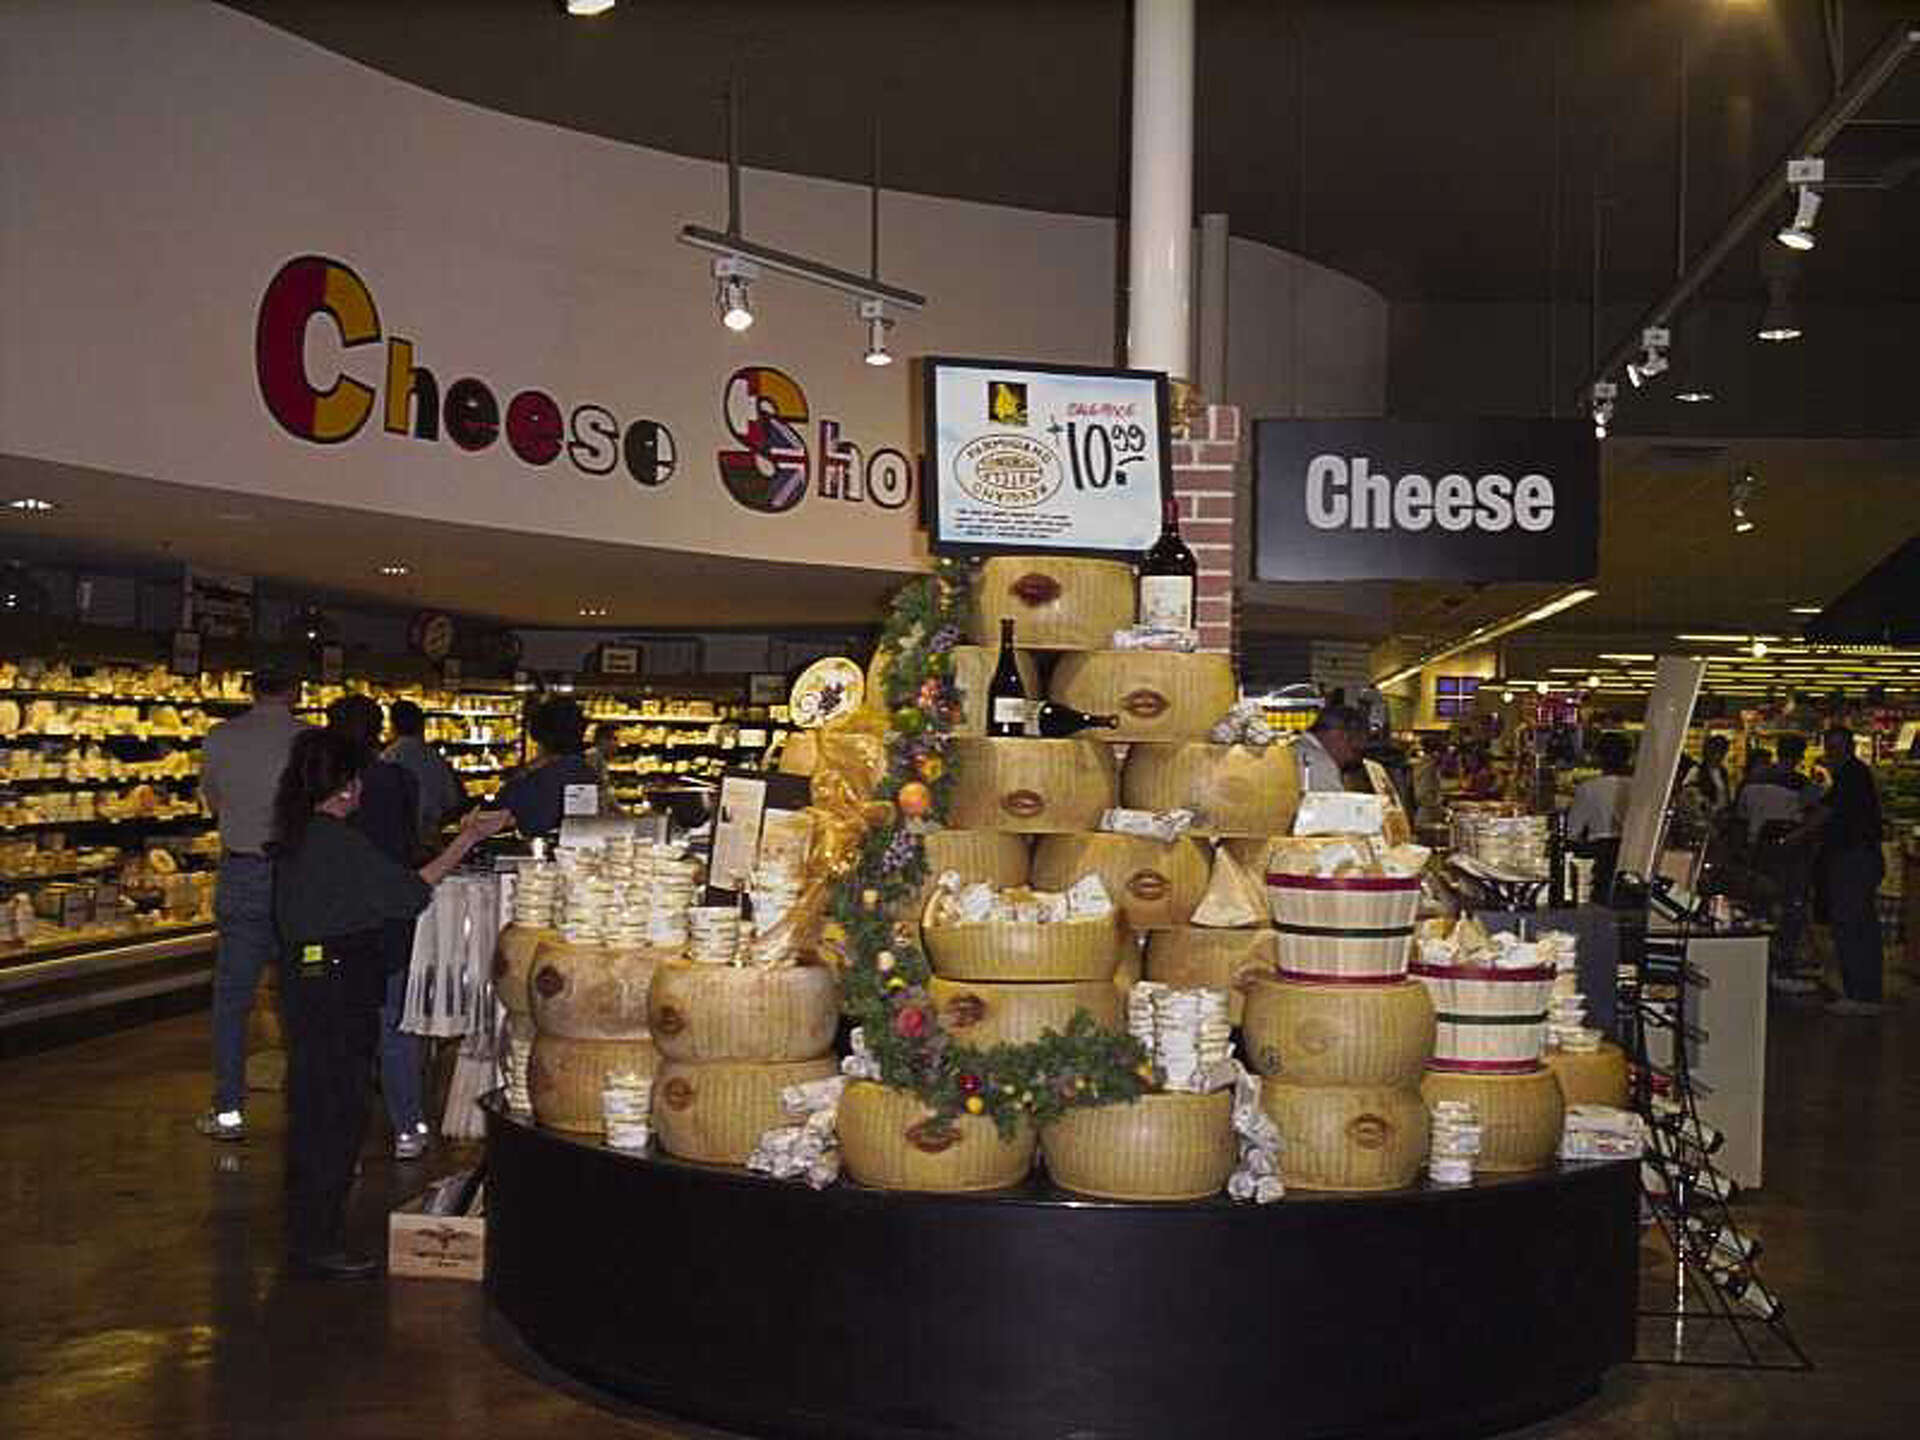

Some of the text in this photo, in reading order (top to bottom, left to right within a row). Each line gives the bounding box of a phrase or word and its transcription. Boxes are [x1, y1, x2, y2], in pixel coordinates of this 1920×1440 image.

[255, 255, 921, 524] Cheese Sho
[1305, 454, 1555, 532] Cheese
